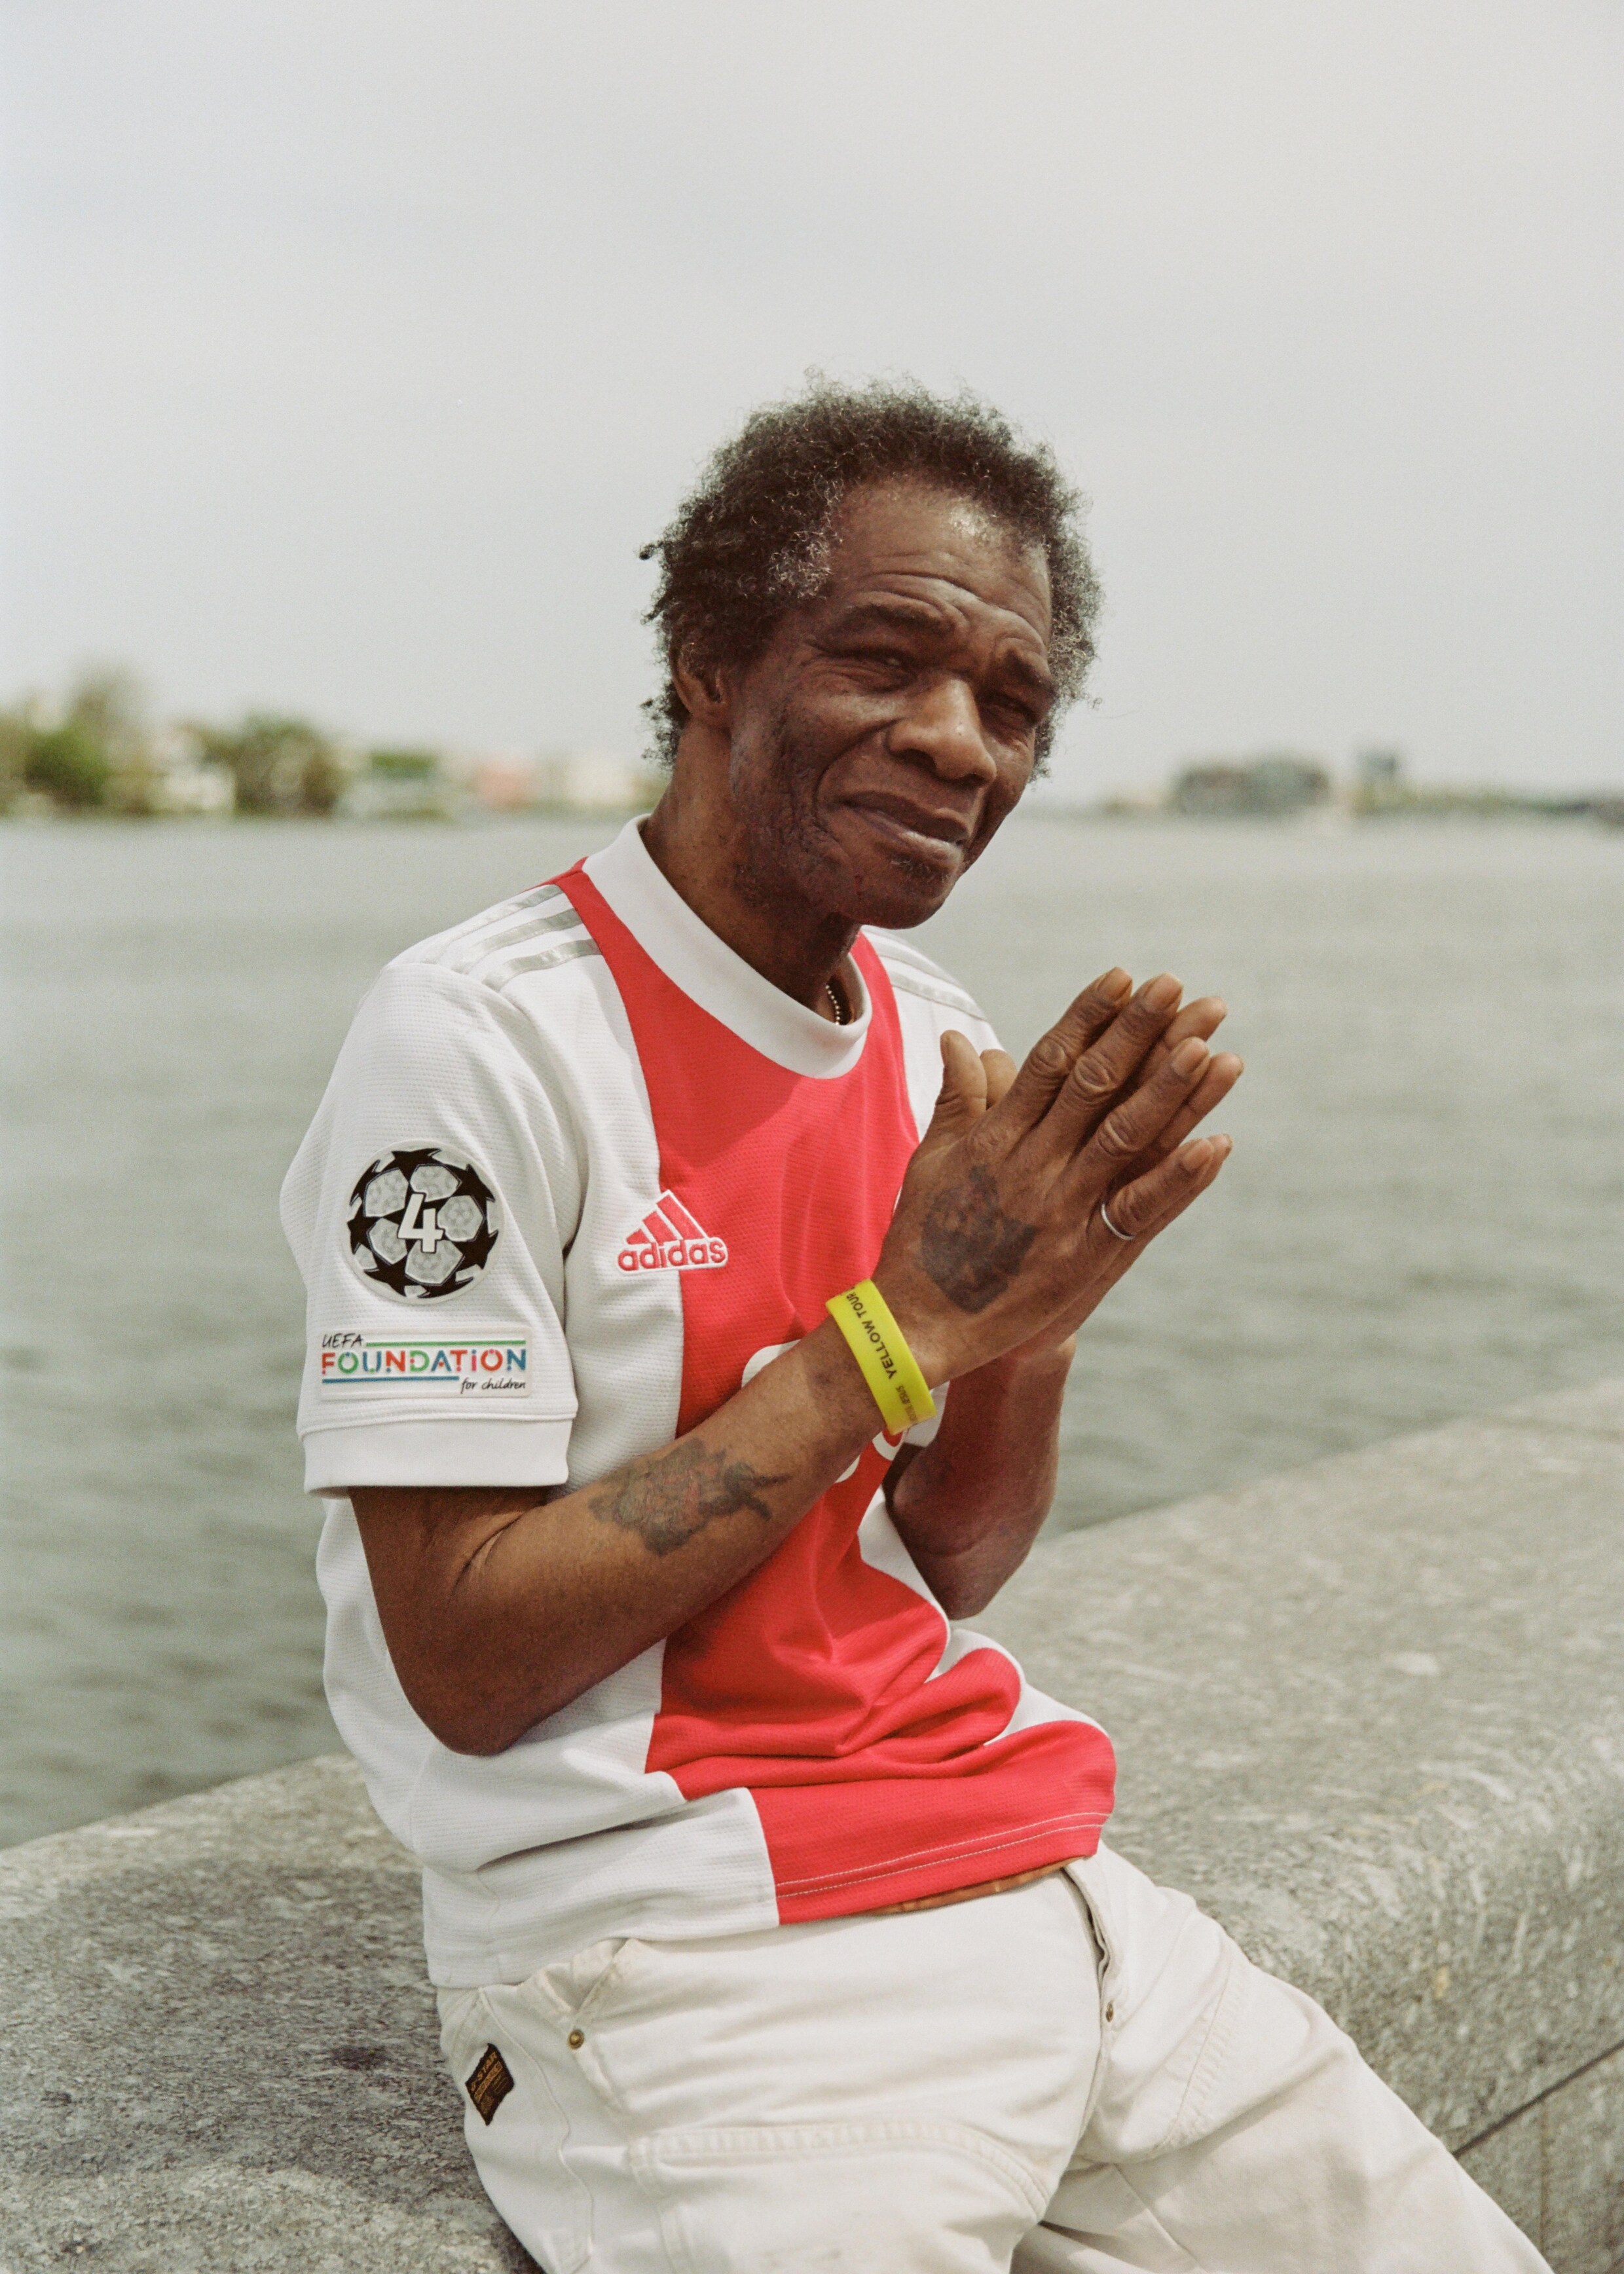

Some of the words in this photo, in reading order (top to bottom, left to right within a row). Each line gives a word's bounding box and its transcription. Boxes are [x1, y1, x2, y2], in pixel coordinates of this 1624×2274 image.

[397, 1192, 444, 1253] 4
[618, 1240, 726, 1271] adidas
[846, 1292, 867, 1318] TOUR
[322, 1333, 363, 1349] UEFA
[862, 1320, 897, 1379] YELLOW
[322, 1349, 527, 1375] FOUNDATION
[460, 1379, 478, 1394] for
[481, 1377, 526, 1390] children
